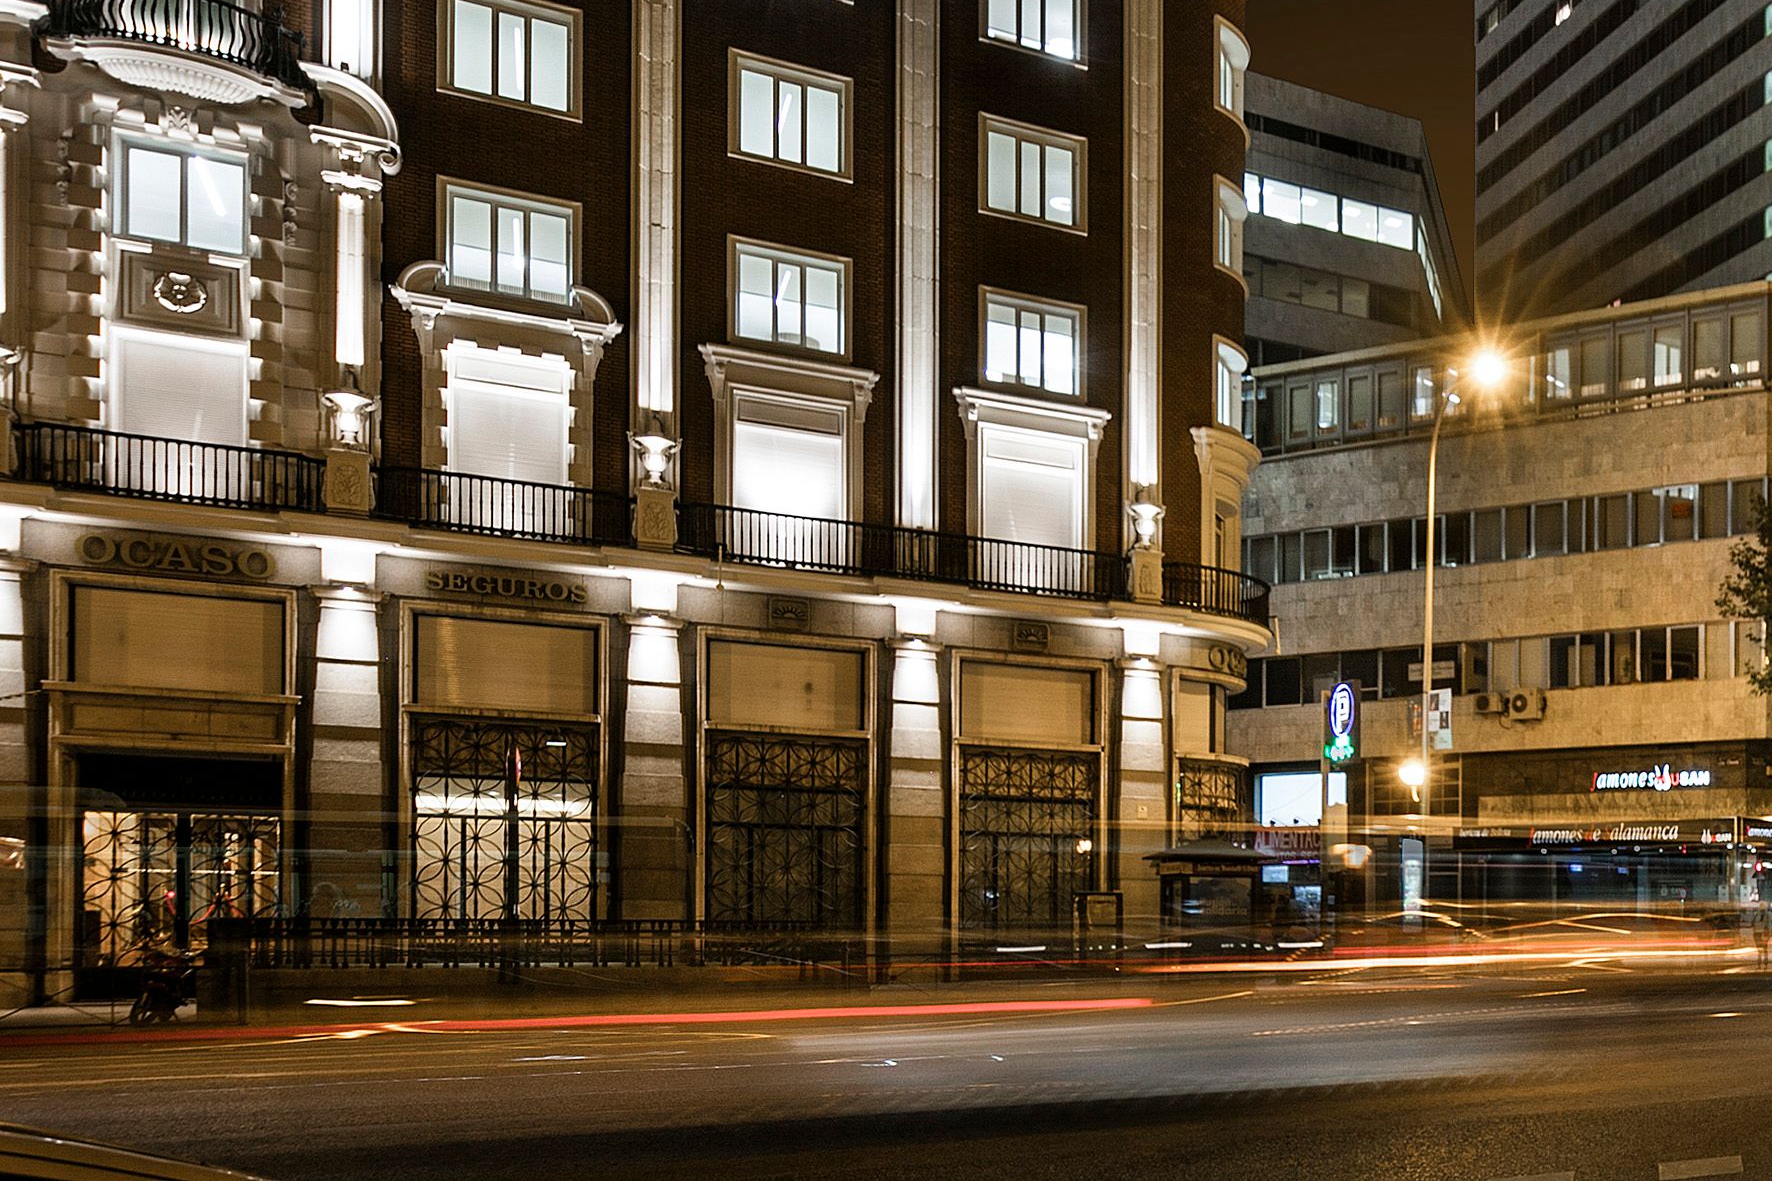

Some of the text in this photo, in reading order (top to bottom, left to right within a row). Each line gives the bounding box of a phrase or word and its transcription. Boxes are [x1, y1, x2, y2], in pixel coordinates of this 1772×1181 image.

[73, 532, 277, 579] OCASO
[424, 569, 588, 603] SEGUROS
[1590, 771, 1655, 792] Jamones
